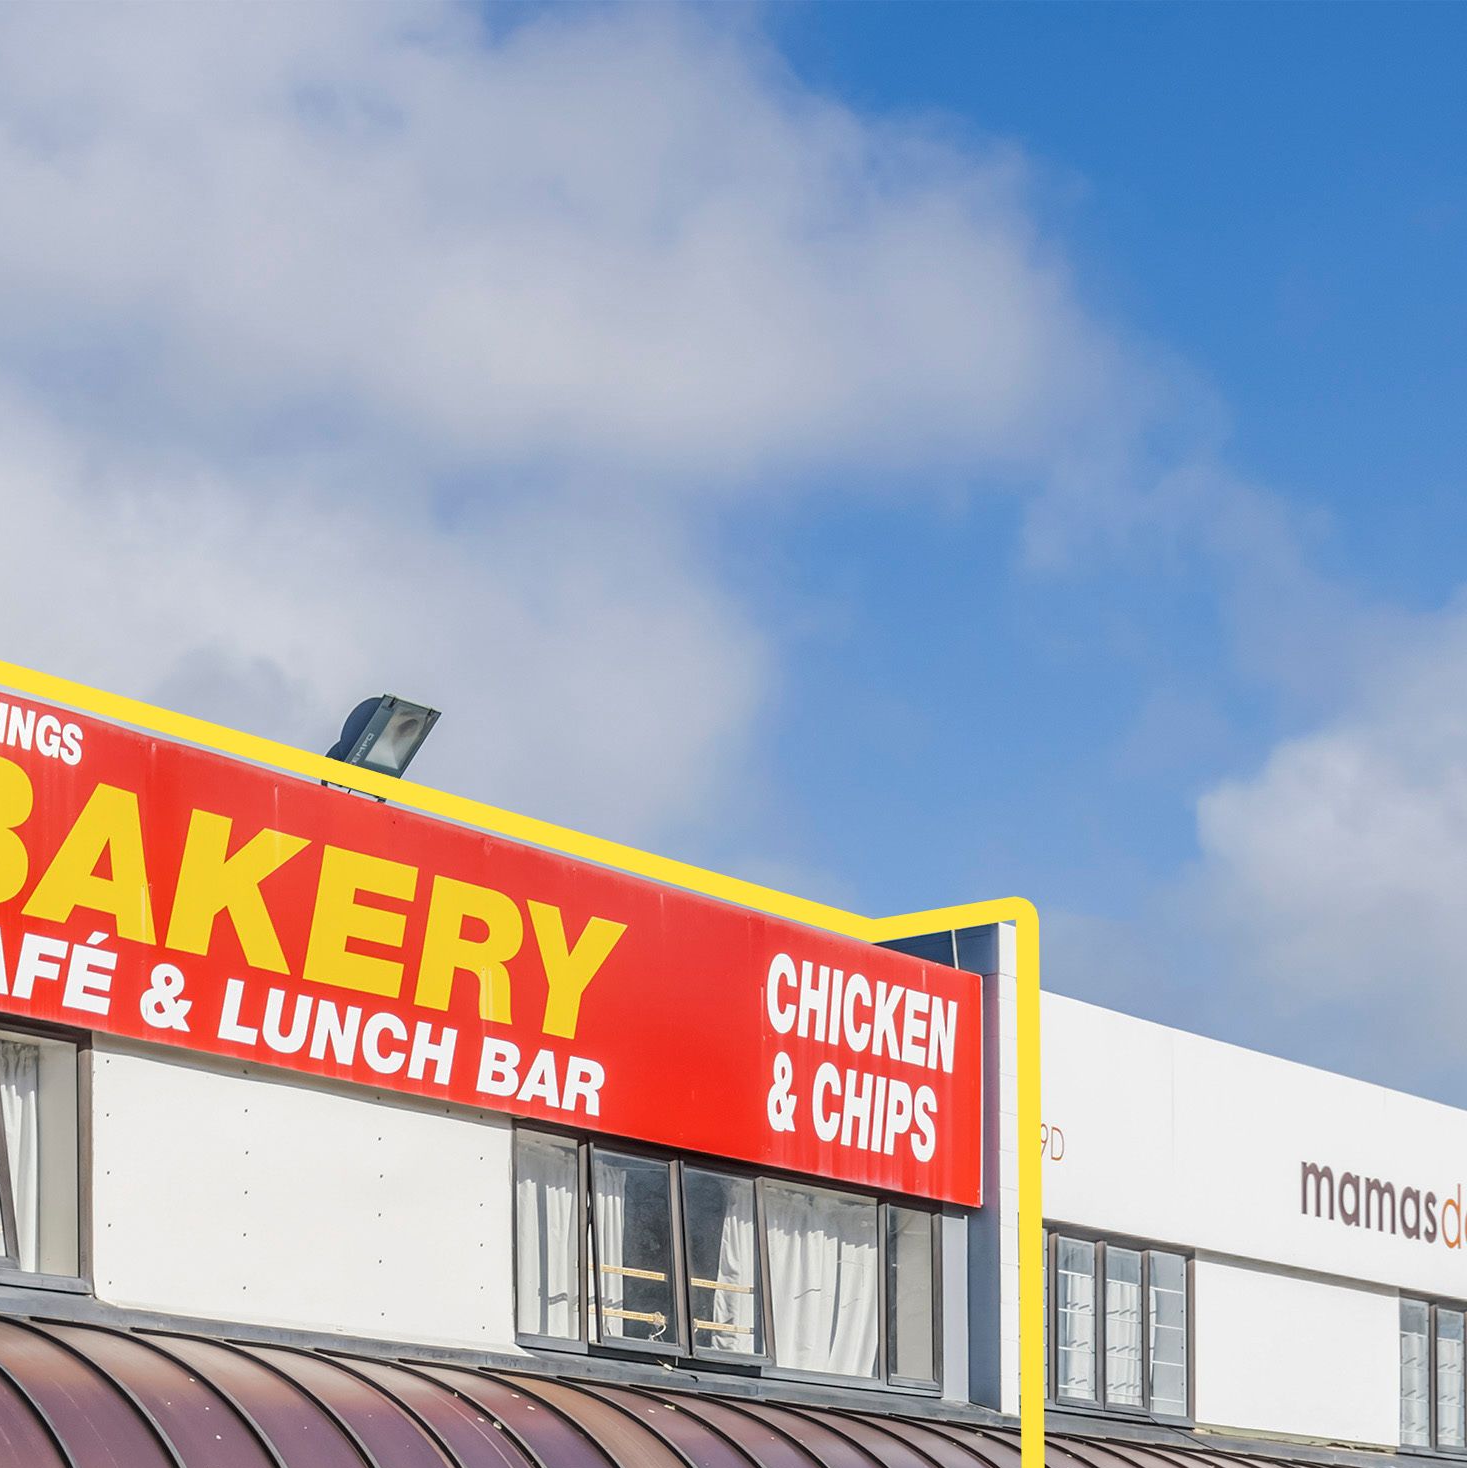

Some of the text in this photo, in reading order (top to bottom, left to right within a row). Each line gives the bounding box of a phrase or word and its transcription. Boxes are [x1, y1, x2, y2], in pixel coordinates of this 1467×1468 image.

[139, 962, 193, 1034] &
[216, 977, 458, 1087] LUNCH
[475, 1039, 607, 1118] BAR
[767, 952, 959, 1075] CHICKEN
[765, 1052, 938, 1164] & CHIPS
[1300, 1160, 1467, 1250] mamasd
